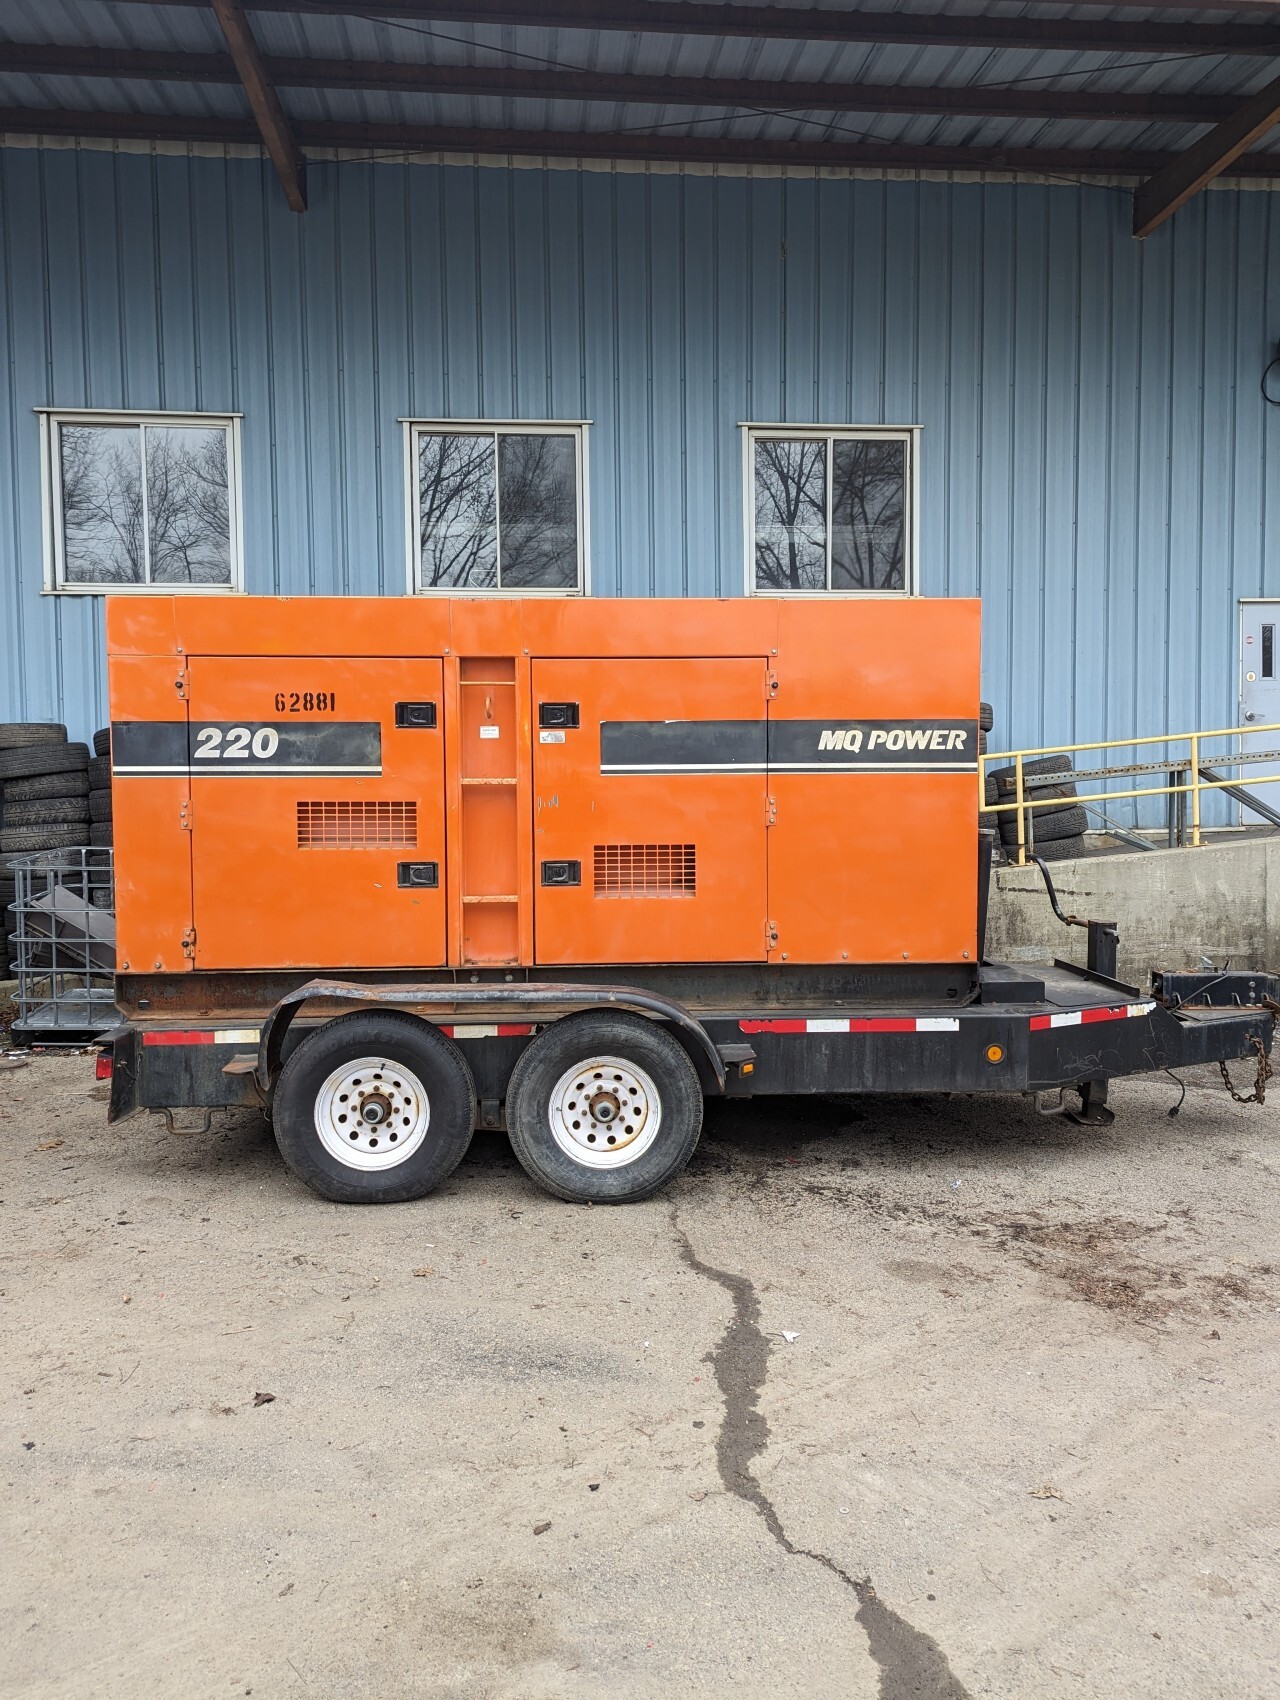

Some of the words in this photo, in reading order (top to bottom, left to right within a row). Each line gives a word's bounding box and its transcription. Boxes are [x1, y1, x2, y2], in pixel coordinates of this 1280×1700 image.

[274, 692, 336, 712] 62881
[193, 727, 280, 759] 220
[817, 729, 862, 754] MQ
[866, 729, 968, 751] POWER
